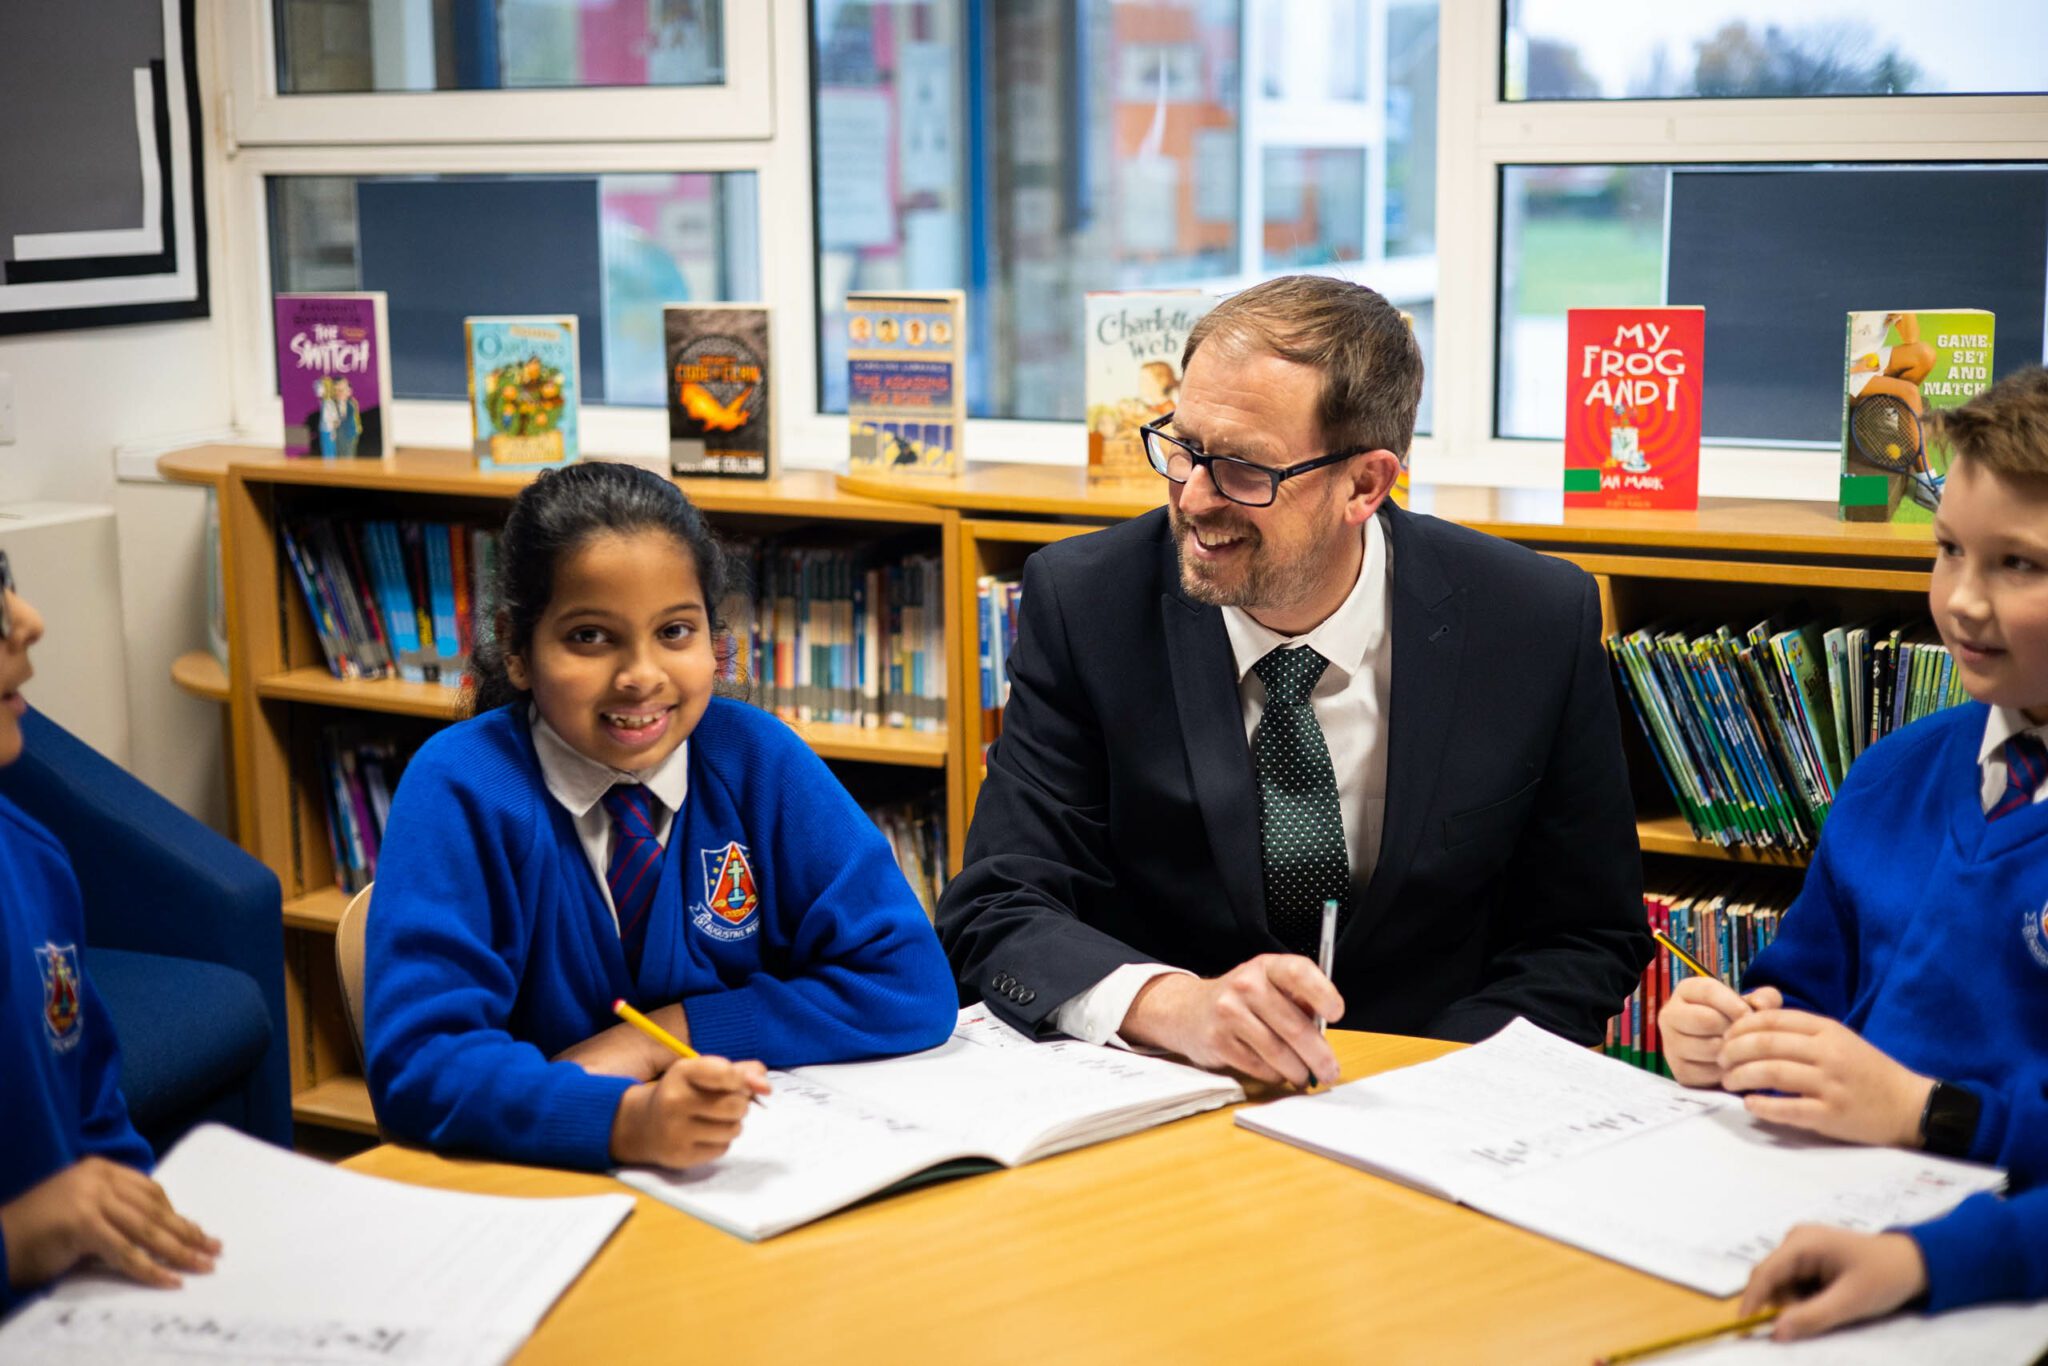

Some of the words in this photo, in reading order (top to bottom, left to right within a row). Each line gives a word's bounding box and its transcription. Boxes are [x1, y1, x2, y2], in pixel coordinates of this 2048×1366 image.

[313, 323, 338, 342] THE
[1582, 345, 1685, 378] FROG
[1953, 350, 1987, 363] SET
[1948, 366, 1987, 380] AND
[1584, 378, 1660, 407] AND
[1666, 376, 1679, 411] I
[1924, 381, 1986, 396] MATCH
[1624, 475, 1664, 490] MARK
